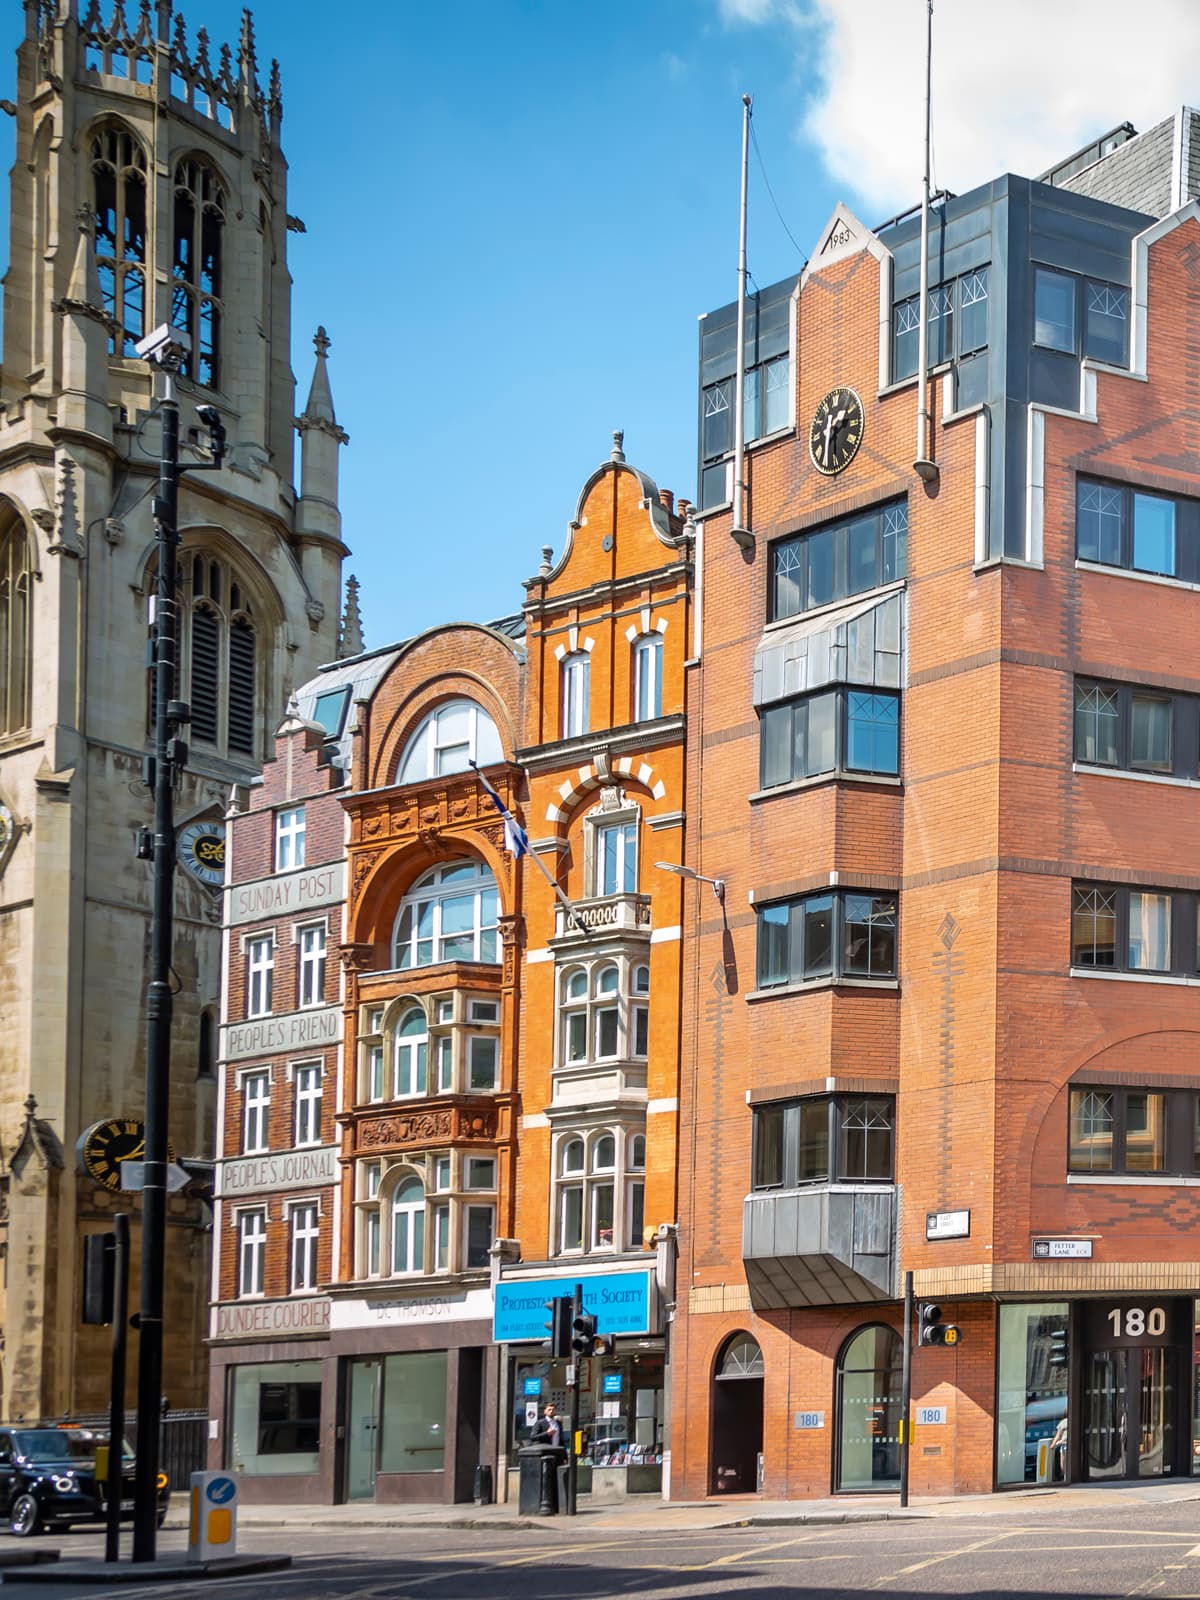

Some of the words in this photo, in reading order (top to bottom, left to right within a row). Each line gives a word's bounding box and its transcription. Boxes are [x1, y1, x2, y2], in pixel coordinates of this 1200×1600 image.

[830, 229, 850, 249] 1983
[239, 881, 292, 915] SUNDAY
[300, 871, 336, 901] POST
[229, 1020, 285, 1054] PEOPLE'S
[290, 1013, 336, 1043] FRIEND
[224, 1157, 277, 1189] PEOPLE'S
[280, 1153, 334, 1182] JOURNAL
[501, 1296, 552, 1312] PROTESTA
[602, 1288, 643, 1304] SOCIETY
[218, 1306, 271, 1334] DUNDEE
[274, 1300, 330, 1328] COURIER
[1108, 1307, 1166, 1337] 180
[800, 1414, 818, 1426] 180
[922, 1410, 940, 1422] 180
